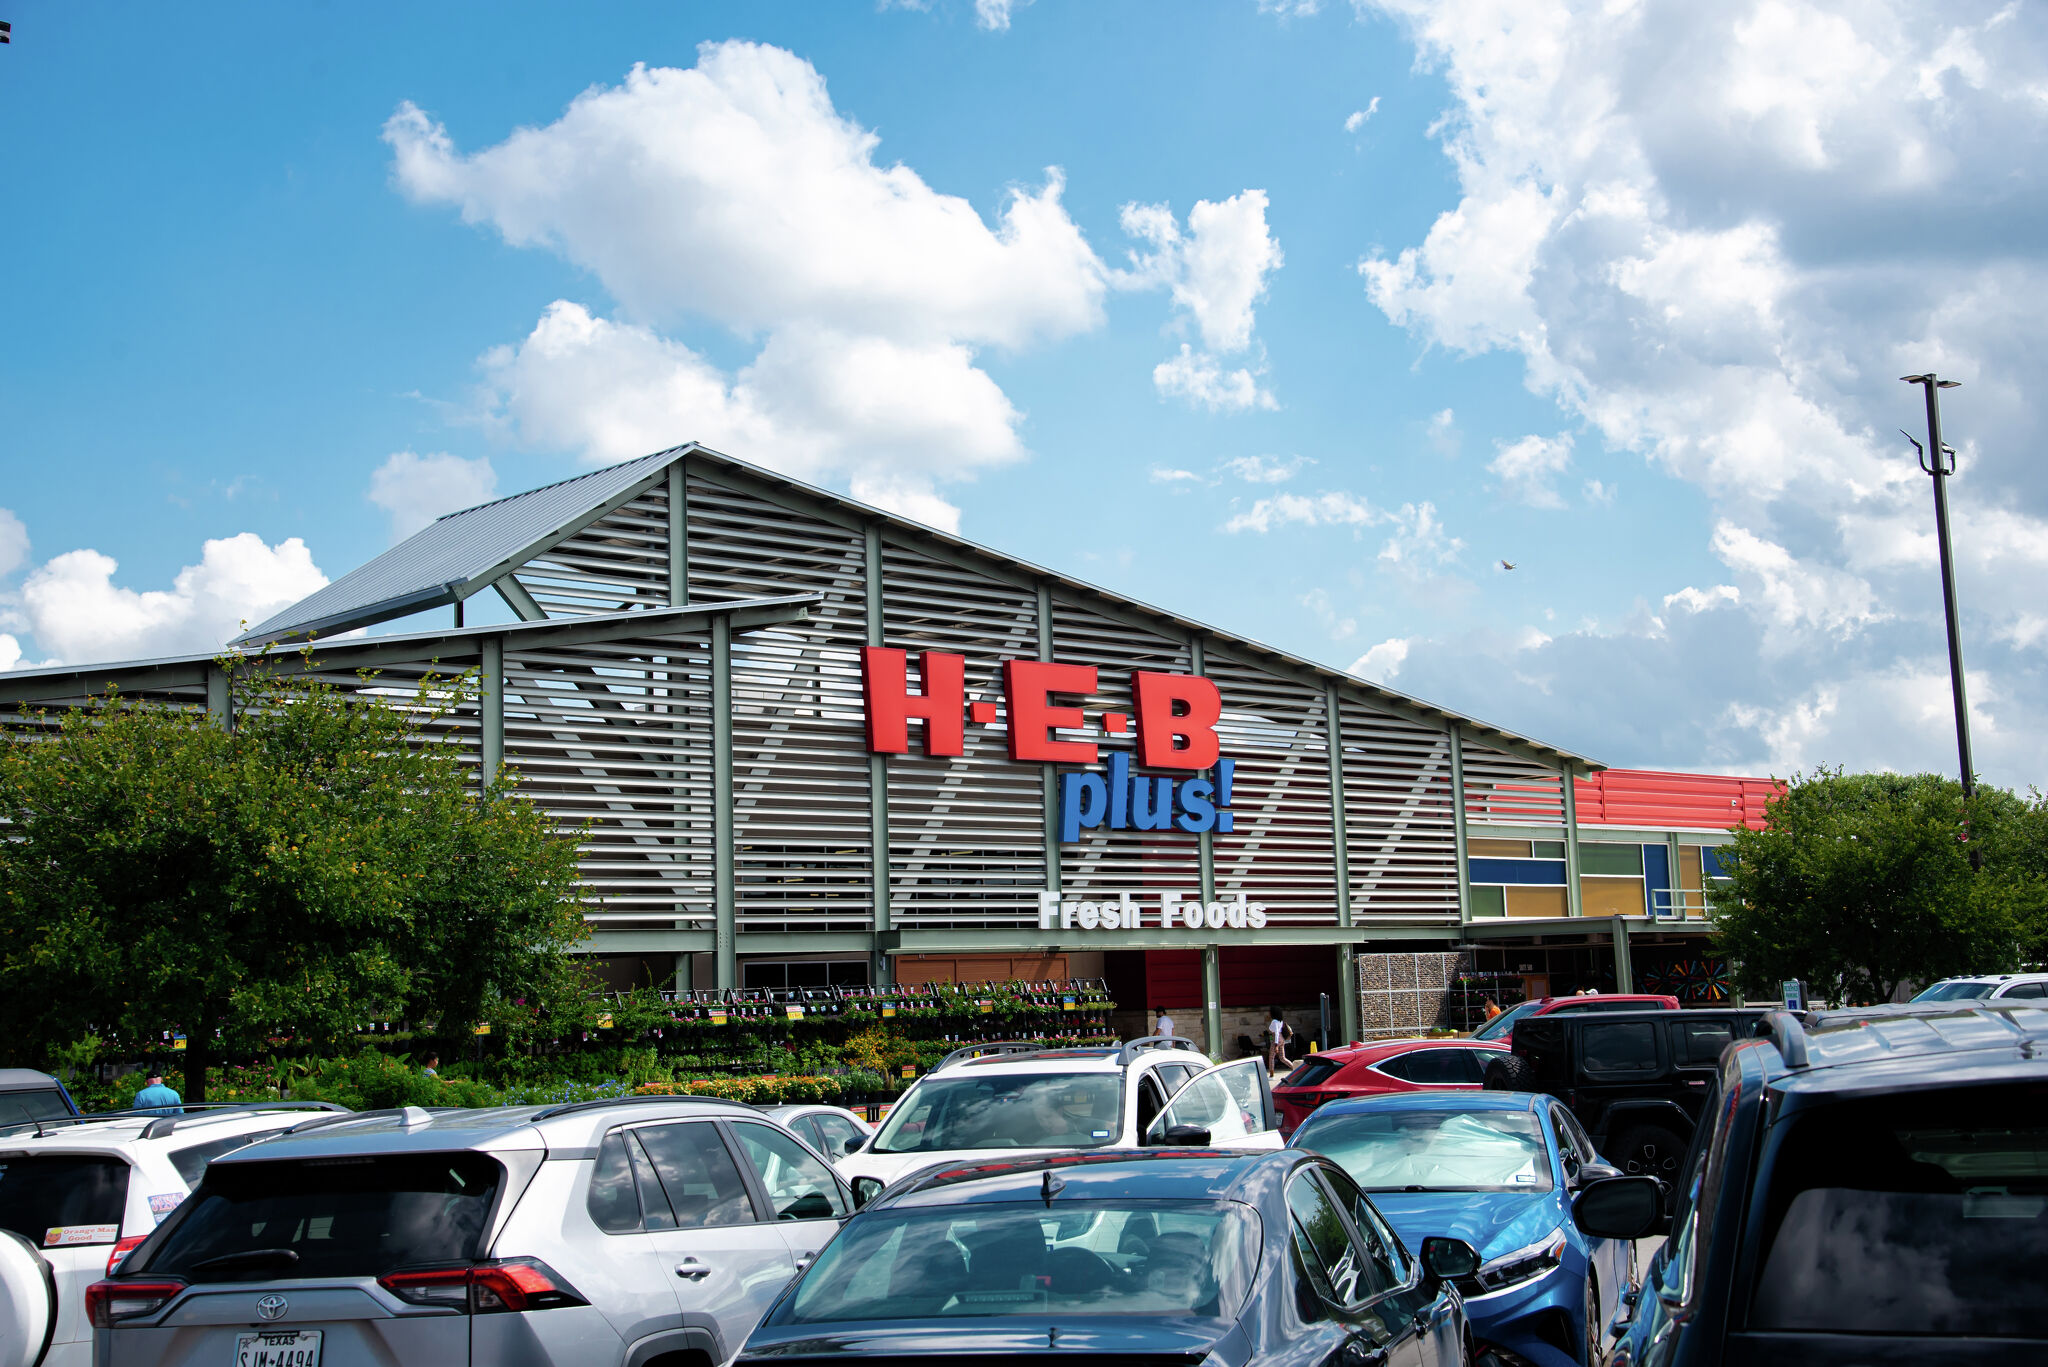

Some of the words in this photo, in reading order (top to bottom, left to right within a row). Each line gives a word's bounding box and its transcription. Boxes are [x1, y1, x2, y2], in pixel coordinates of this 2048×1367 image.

[1059, 752, 1236, 843] plus!
[1038, 891, 1141, 930] Fresh
[1160, 892, 1268, 930] Foods
[264, 1336, 295, 1346] TEXAS
